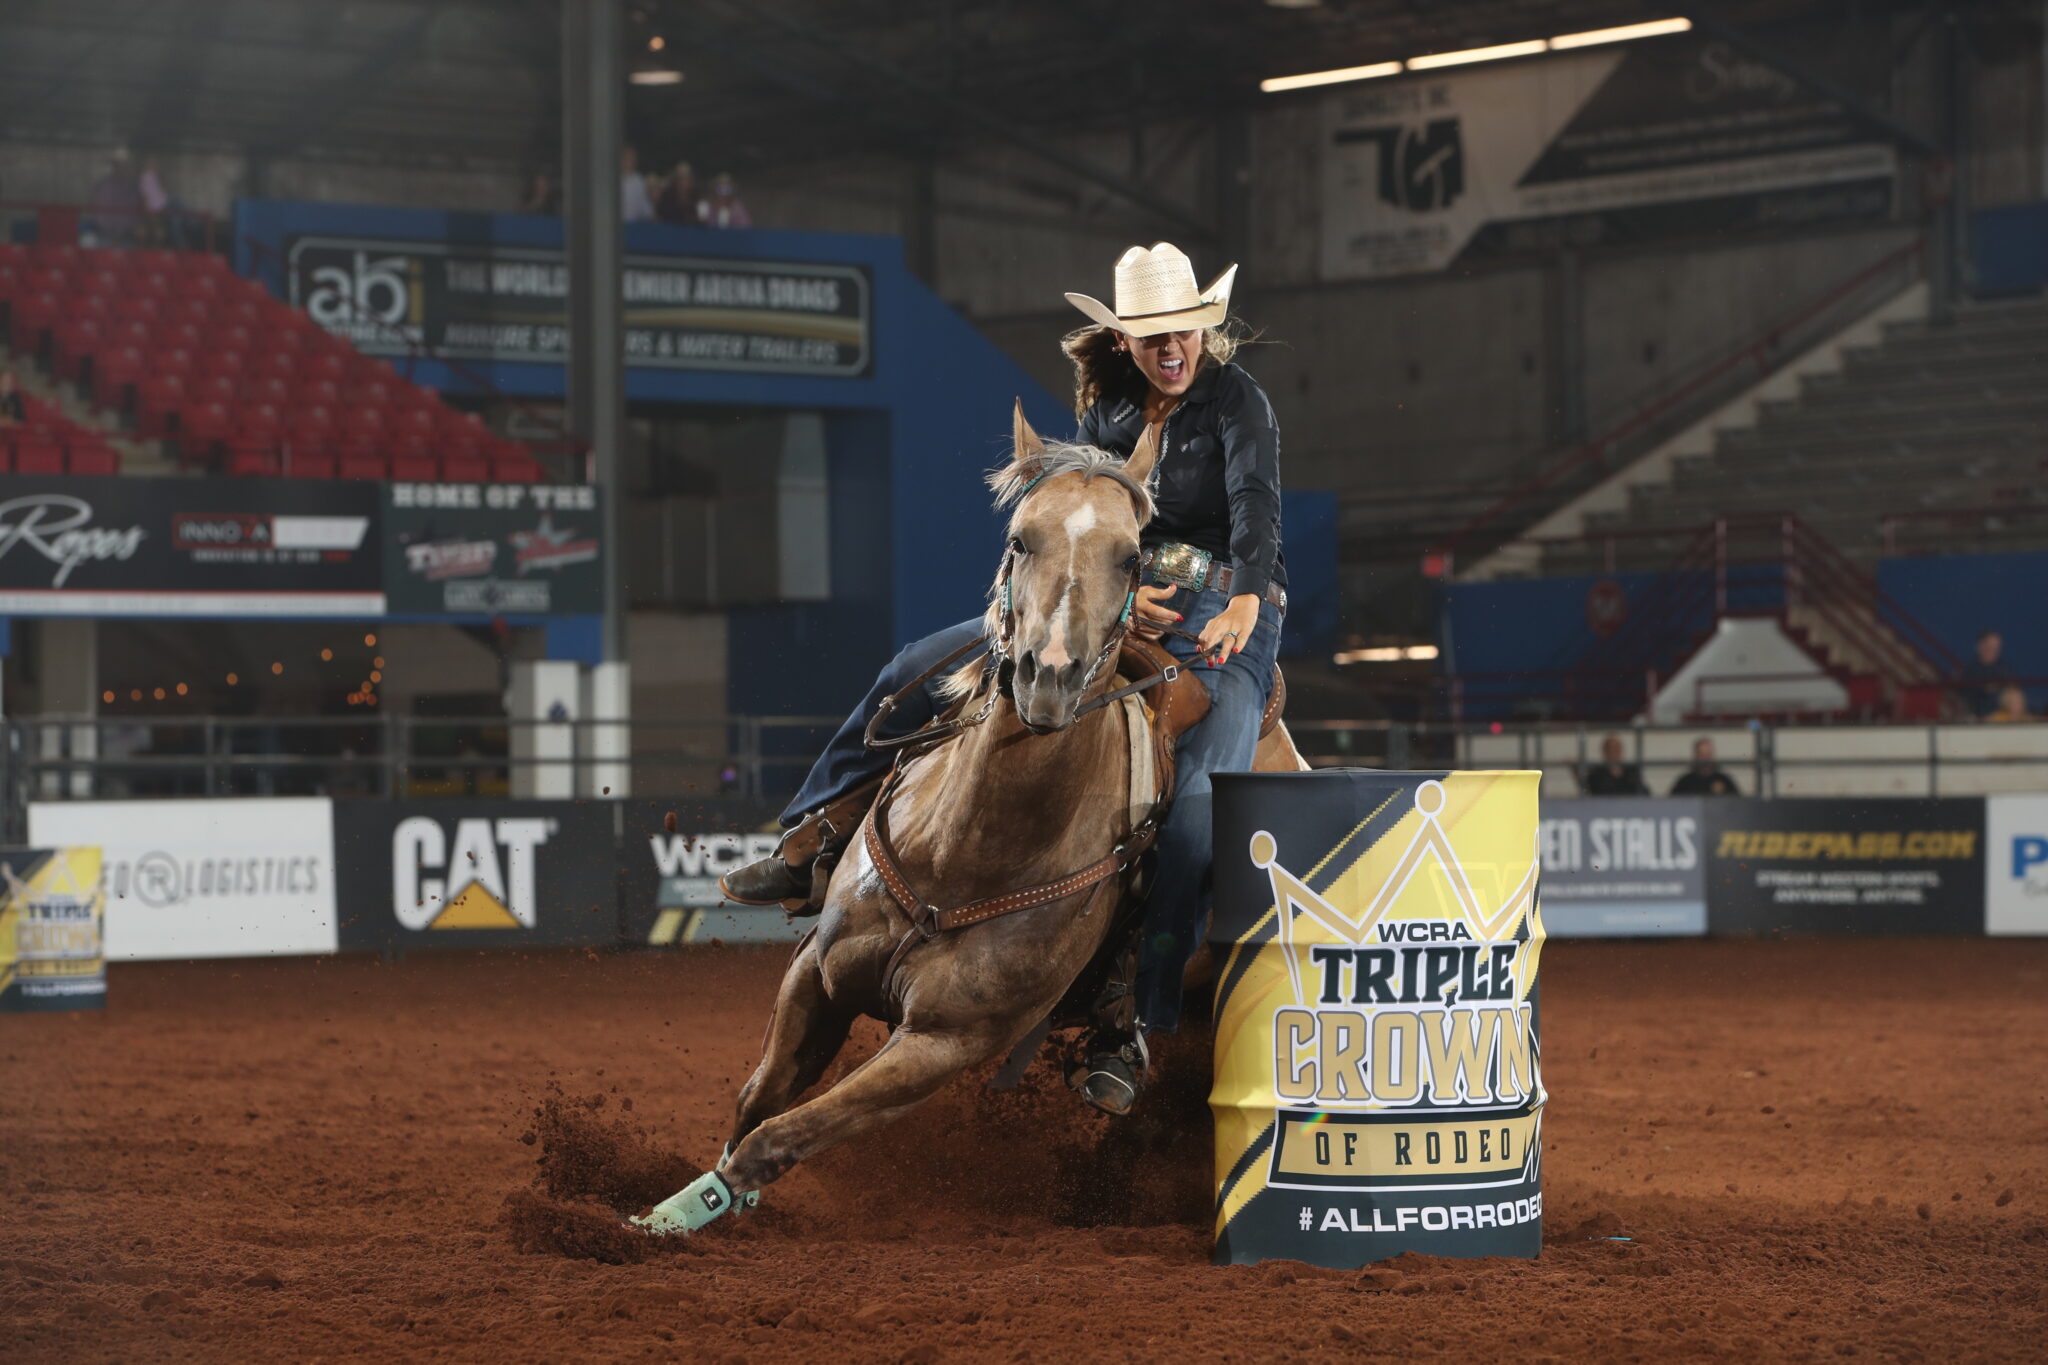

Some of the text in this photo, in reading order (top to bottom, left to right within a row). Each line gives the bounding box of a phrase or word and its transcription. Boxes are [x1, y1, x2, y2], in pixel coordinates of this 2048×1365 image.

[392, 483, 596, 510] HOME OF THE
[1588, 816, 1698, 871] STALLS
[184, 856, 319, 897] LOGISTICS
[392, 816, 547, 931] CAT
[1377, 922, 1473, 943] WCRA
[1312, 944, 1518, 1005] TRIPLE
[1276, 1007, 1532, 1103] CROWN
[1314, 1126, 1512, 1167] OF RODEO
[1298, 1191, 1543, 1233] #ALLFORRODEO
